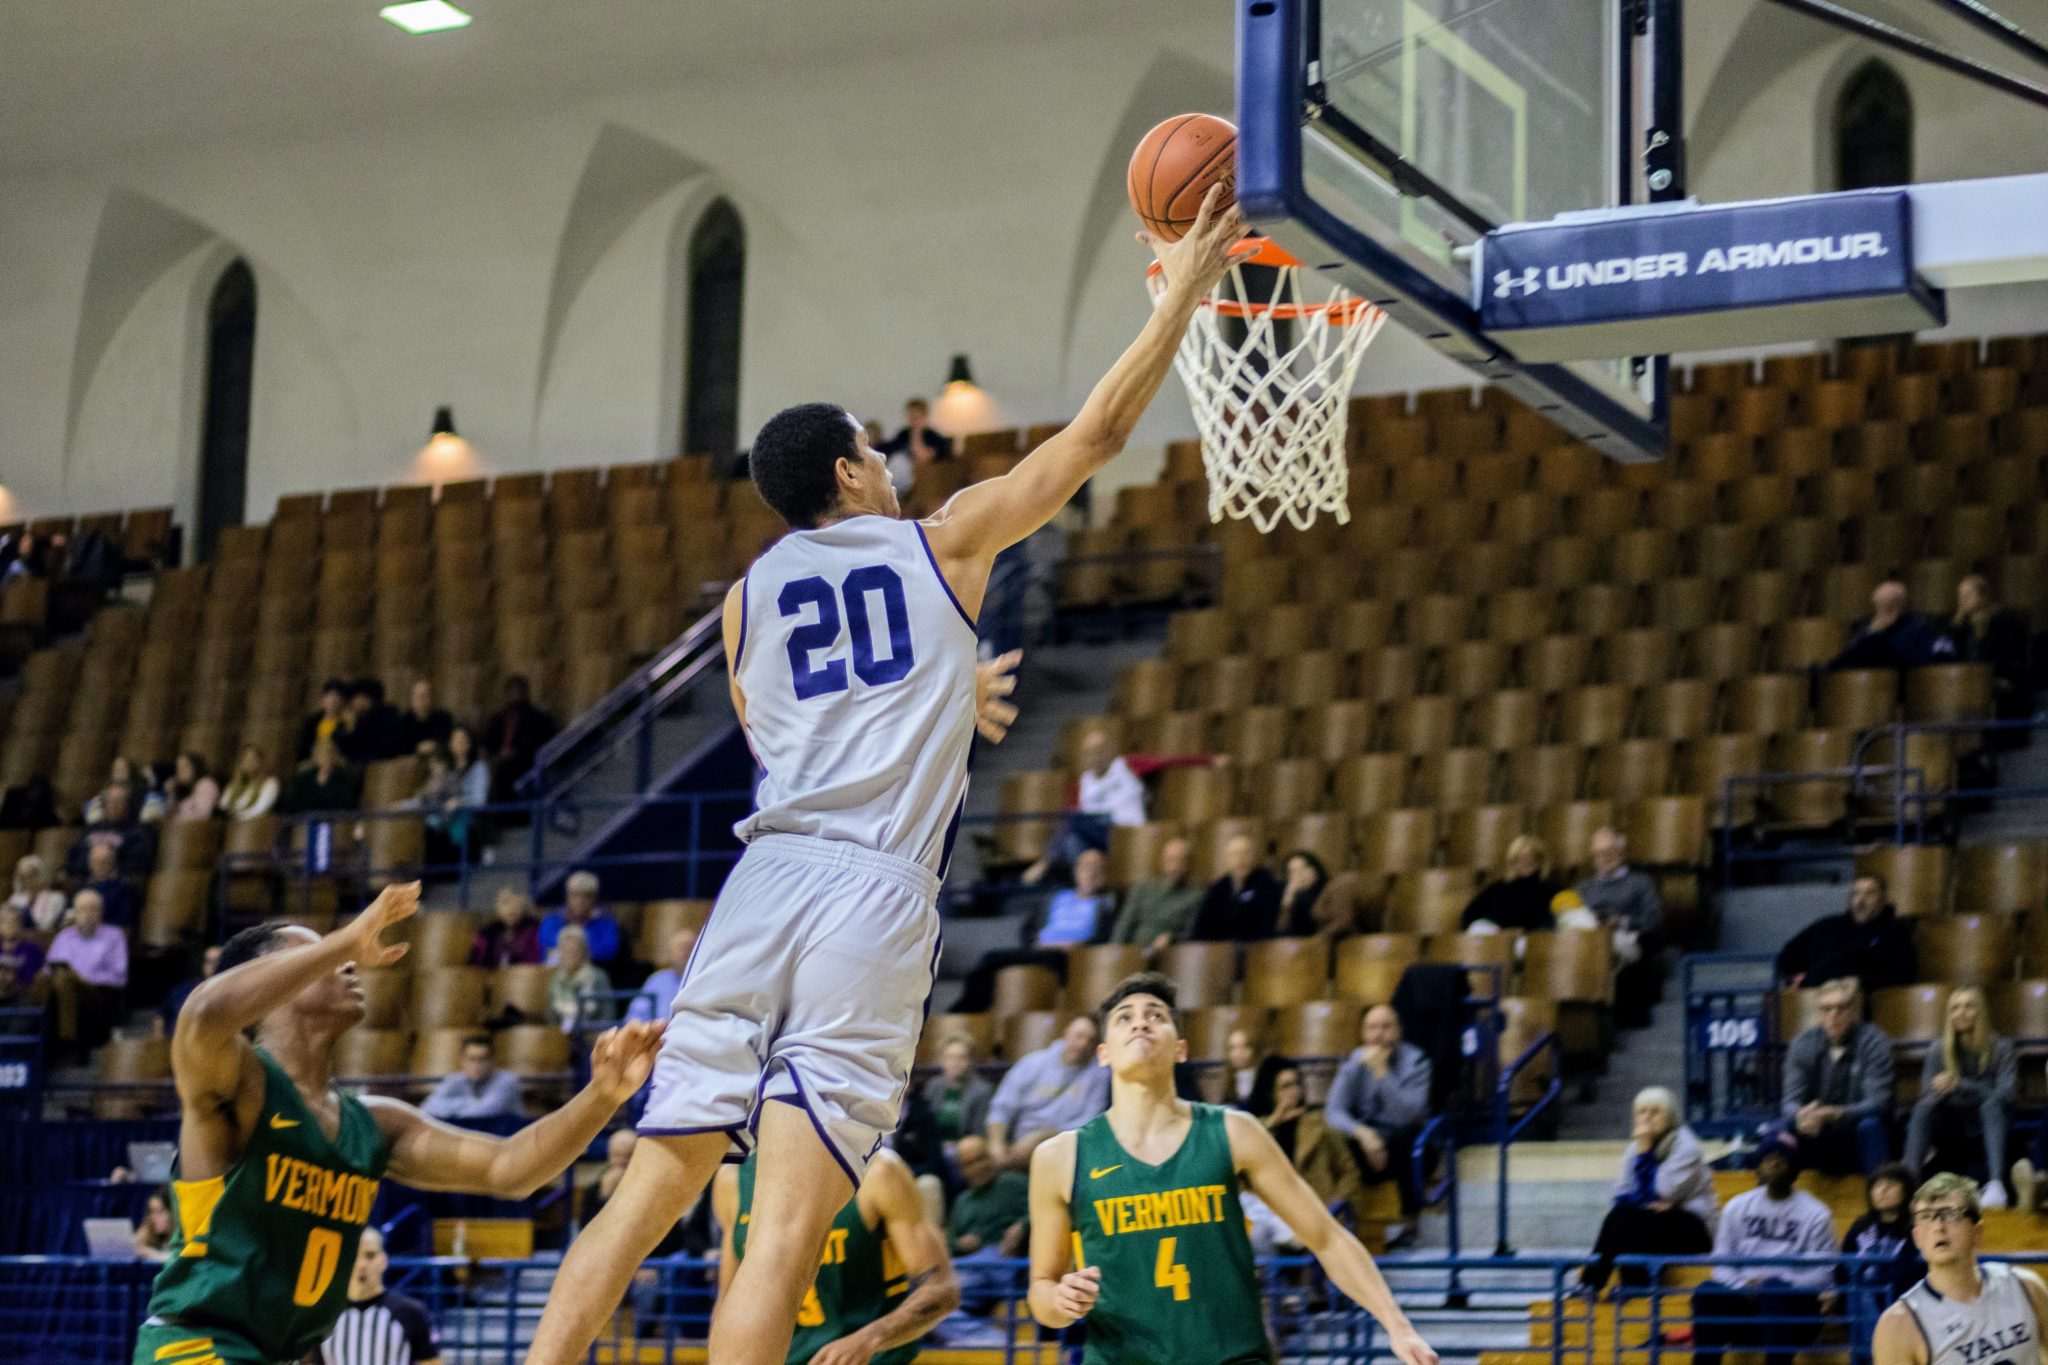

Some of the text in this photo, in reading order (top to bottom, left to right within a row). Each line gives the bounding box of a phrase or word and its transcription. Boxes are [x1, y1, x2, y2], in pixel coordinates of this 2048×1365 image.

[1546, 252, 1688, 291] UNDER
[777, 564, 915, 701] 20
[1707, 1019, 1758, 1048] 105
[1092, 1184, 1227, 1236] VERMONT
[293, 1226, 343, 1307] 0
[1154, 1236, 1191, 1301] 4
[1954, 1321, 2031, 1364] YALE
